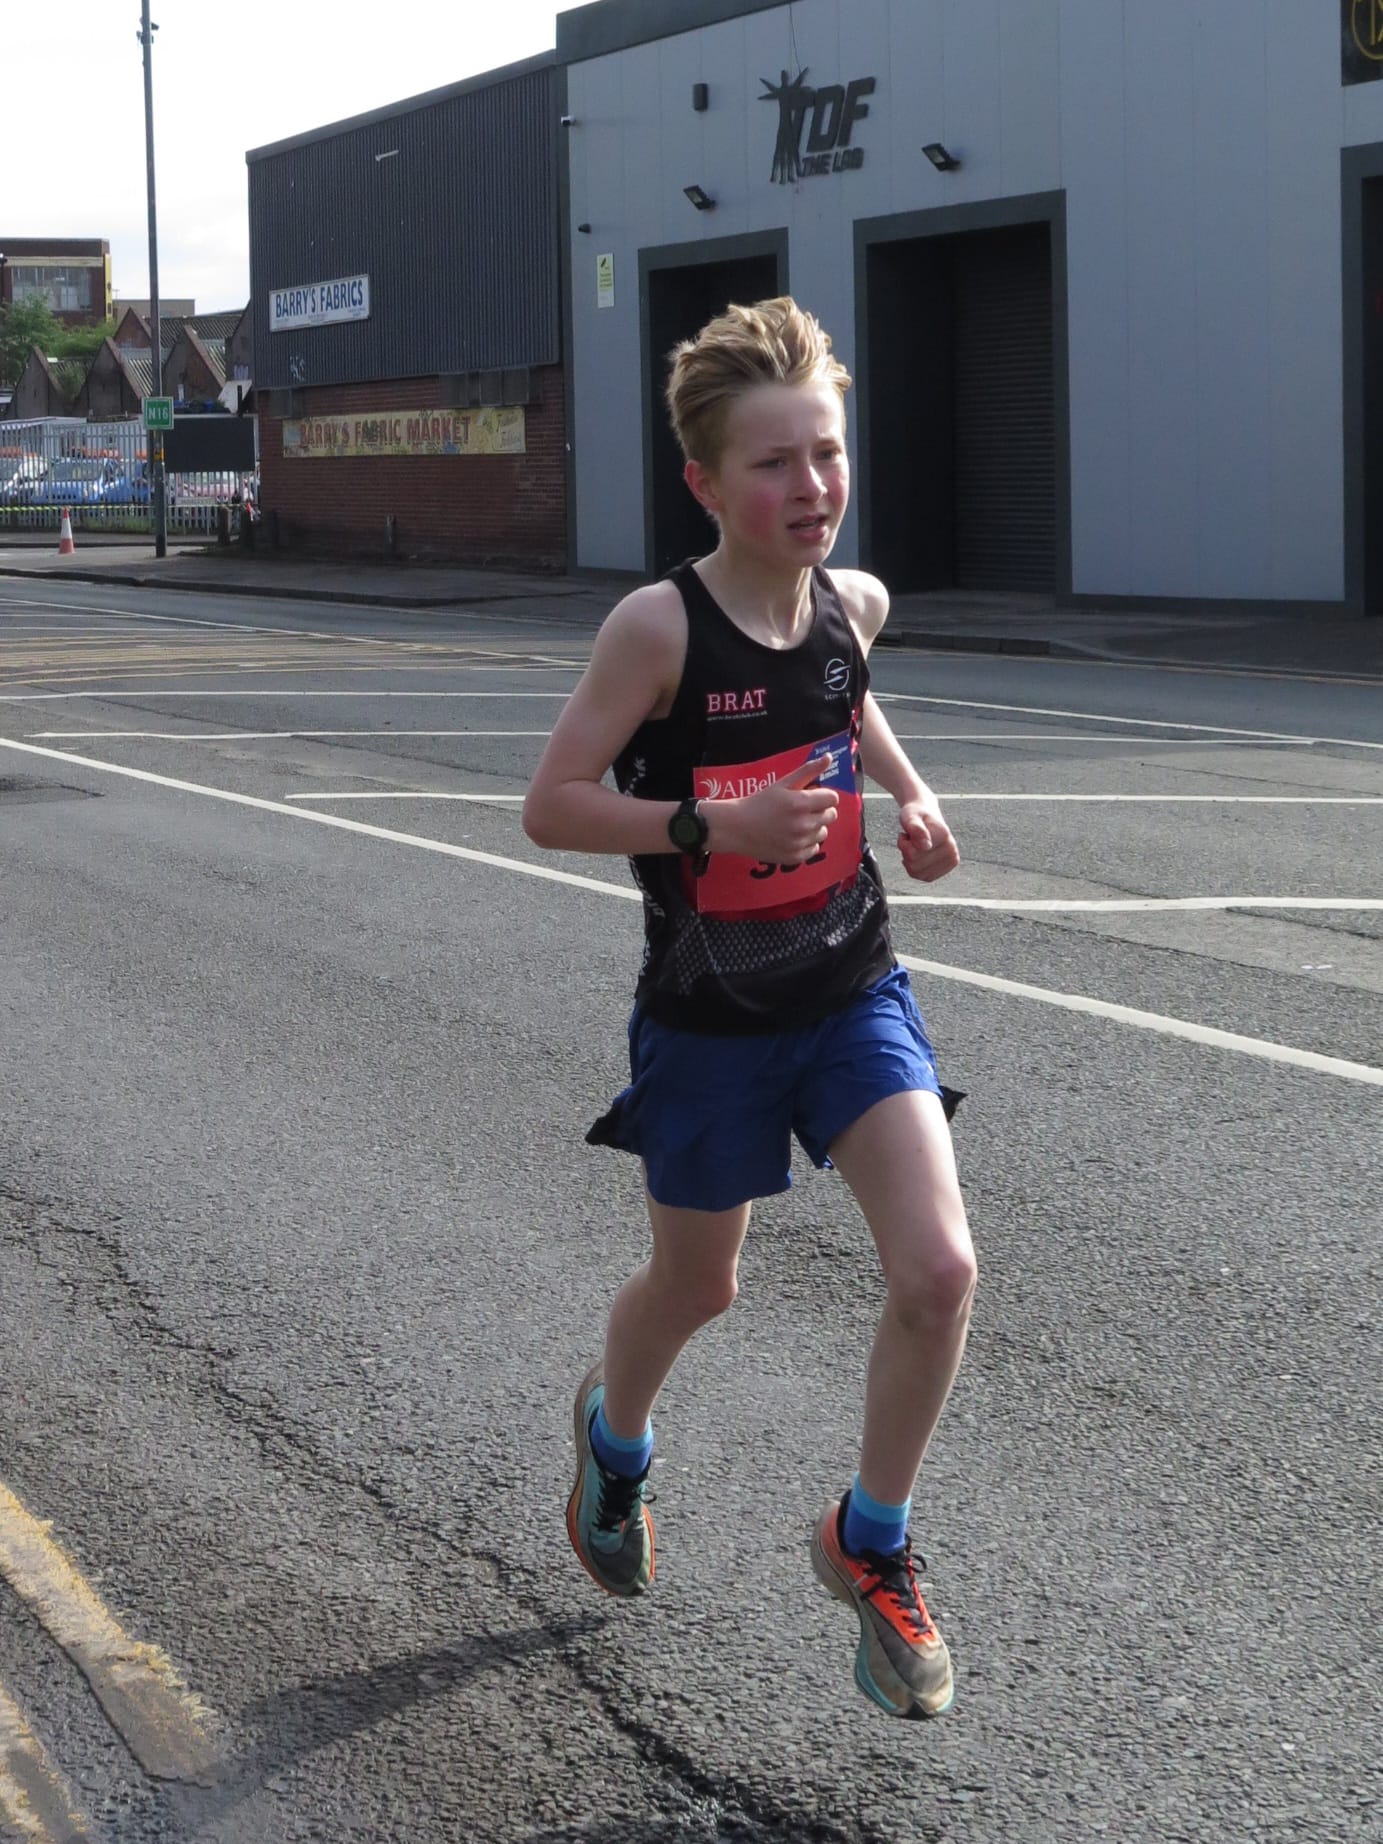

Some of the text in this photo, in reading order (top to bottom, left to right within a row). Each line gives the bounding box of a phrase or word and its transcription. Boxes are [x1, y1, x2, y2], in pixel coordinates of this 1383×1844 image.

[275, 287, 317, 318] BARRY'S
[320, 279, 363, 312] FABRICS
[299, 421, 350, 448] BARRY'S
[355, 419, 401, 445] FABRIC
[407, 416, 471, 443] MARKET
[706, 688, 767, 713] BRAT
